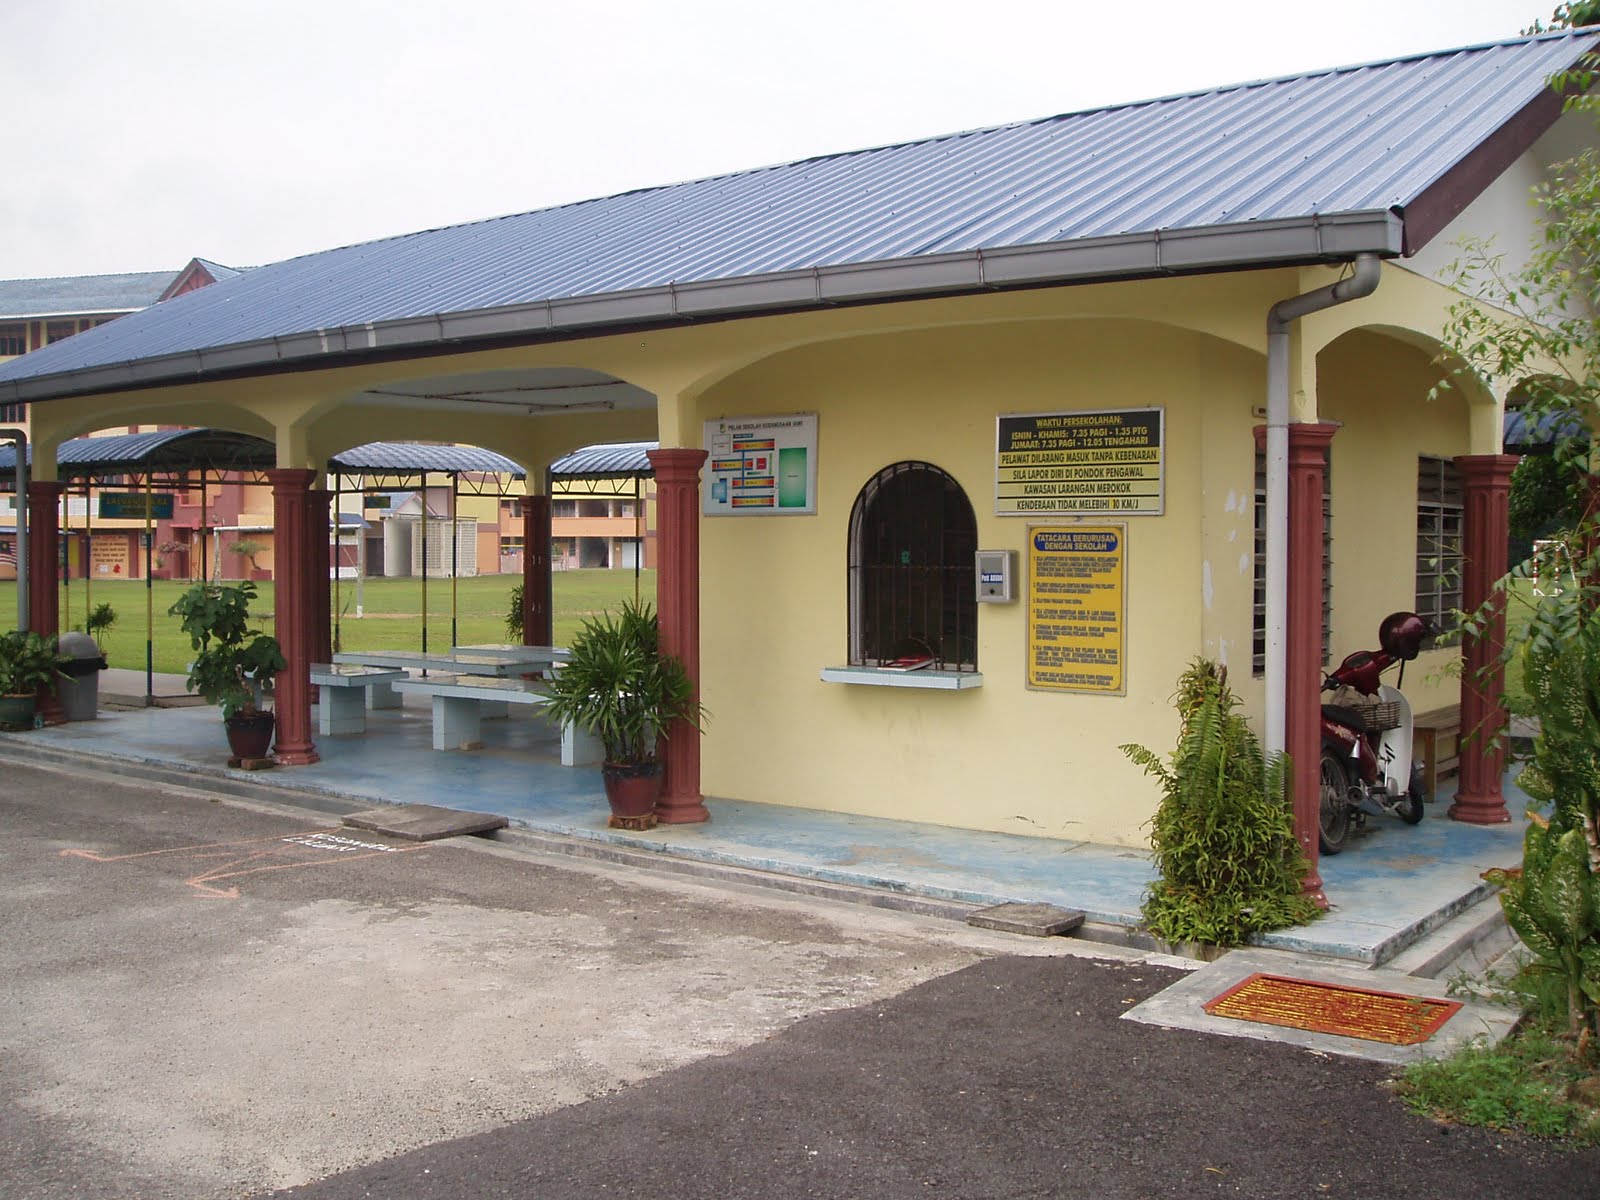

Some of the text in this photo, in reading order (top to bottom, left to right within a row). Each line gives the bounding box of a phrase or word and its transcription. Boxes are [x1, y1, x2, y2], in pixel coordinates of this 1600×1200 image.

[1036, 415, 1122, 428] WAKTU PERSEKOLAHAN:
[1011, 431, 1032, 440] ISNIN
[1038, 430, 1068, 439] KHAMIS:
[1072, 429, 1088, 437] 7.35
[1089, 428, 1108, 437] PAGI
[1115, 427, 1131, 436] 1.35
[1132, 426, 1147, 435] PTG
[1010, 440, 1040, 449] JUMAAT:
[1042, 439, 1057, 448] 7.35
[1058, 439, 1076, 448] PAGI
[1083, 438, 1103, 447] 12.05
[1104, 436, 1148, 446] TENGAHARI
[1001, 449, 1157, 464] PELAWAT DILARANG MASUK TANPA KEBENARAN
[1012, 467, 1144, 480] SILA LAPOR DIRI DI PONDOK PENGAWAL
[1024, 483, 1131, 495] KAWASAN LARANGAN MEROKOK
[1016, 500, 1056, 510] KENDERAAN
[1058, 499, 1078, 509] TIDAK
[1079, 499, 1110, 509] MELEBIHI
[1121, 498, 1139, 509] KM/J
[1037, 534, 1116, 542] TATACARA BERURUSAN
[1044, 542, 1107, 550] DENGAN SEKOLAH
